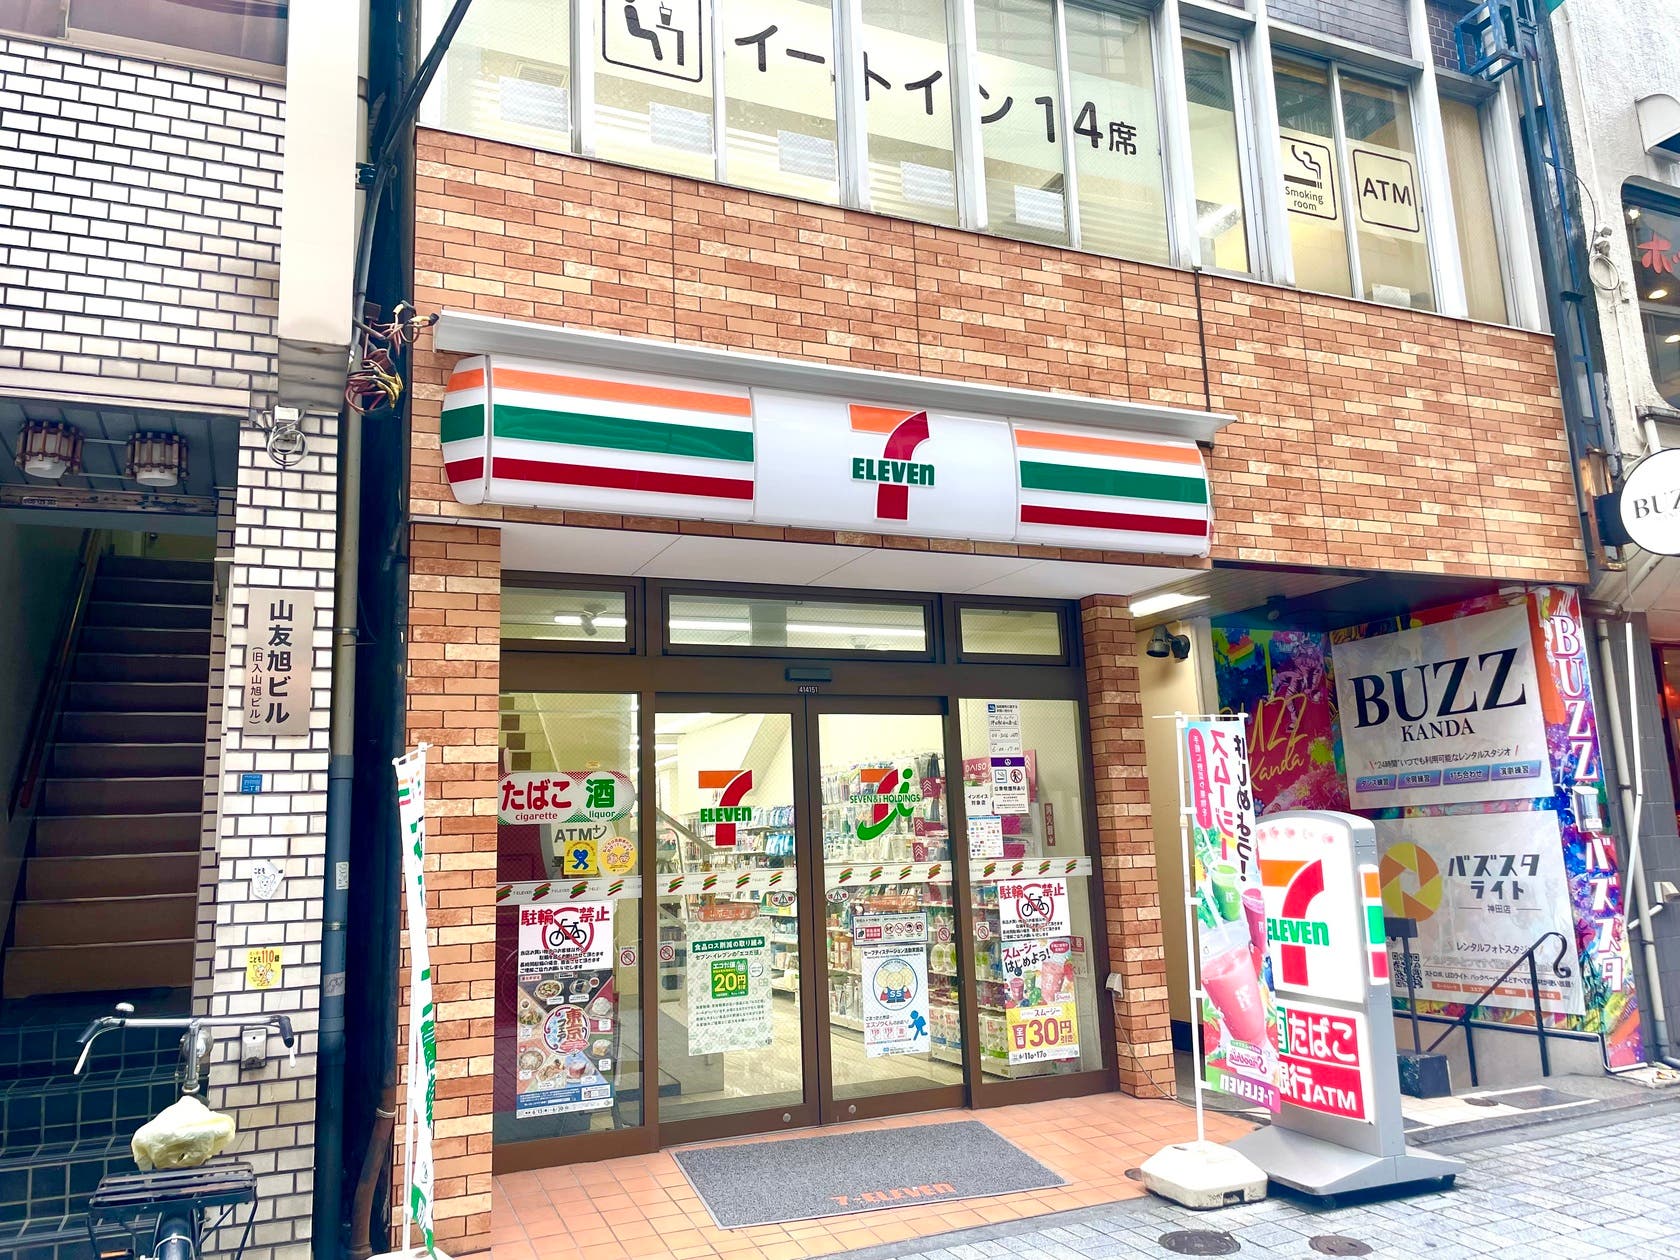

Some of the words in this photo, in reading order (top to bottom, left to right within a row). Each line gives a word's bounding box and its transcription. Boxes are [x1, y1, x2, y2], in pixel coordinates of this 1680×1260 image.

[1285, 185, 1324, 205] Smoking
[1363, 177, 1412, 206] ATM
[1293, 198, 1317, 211] room
[265, 599, 293, 724] 山友旭ビル
[1349, 648, 1527, 729] BUZZ
[1550, 615, 1599, 782] BUZZ
[1401, 718, 1475, 742] KANDA
[501, 778, 572, 811] たばこ
[586, 779, 615, 809] 酒
[883, 794, 921, 803] HOLDINGS
[515, 812, 558, 822] cigarette
[589, 810, 616, 821] liquor
[1448, 854, 1540, 876] バズスタ
[1000, 885, 1024, 899] 駐輪
[1042, 883, 1065, 896] 禁止
[1471, 880, 1524, 900] ライト
[521, 909, 554, 926] 駐輪
[579, 906, 610, 923] 禁止
[1487, 904, 1511, 914] 神田店
[1289, 1012, 1356, 1062] たばこ
[829, 1181, 957, 1206] 7-ELEVEN
